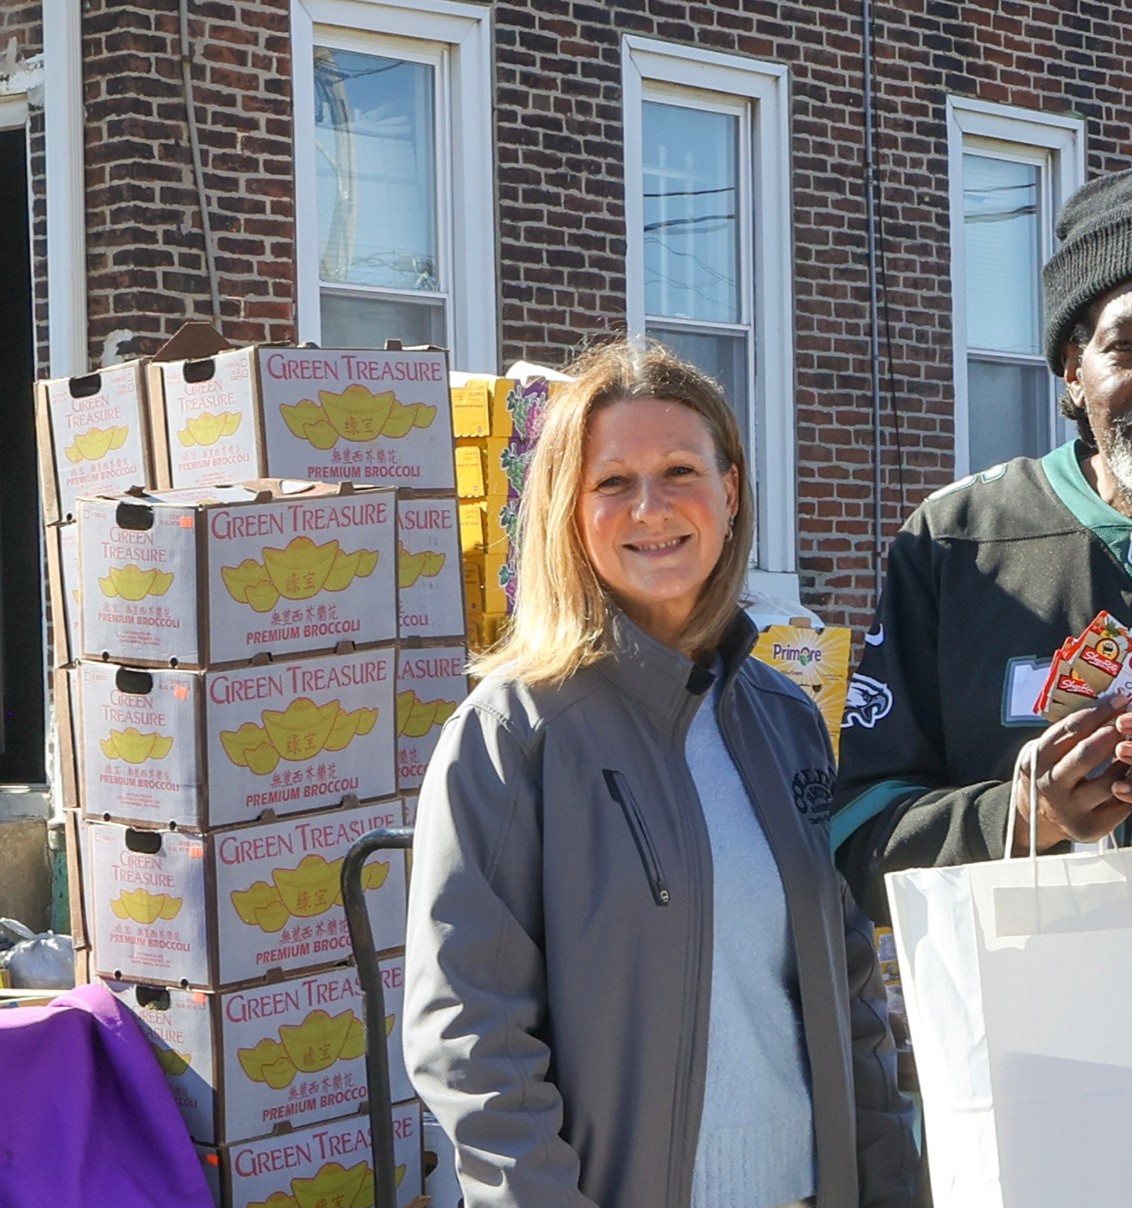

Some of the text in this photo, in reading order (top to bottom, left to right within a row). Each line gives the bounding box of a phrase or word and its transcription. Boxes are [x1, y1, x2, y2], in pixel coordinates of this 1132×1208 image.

[267, 354, 339, 380] GREEN
[341, 355, 442, 381] TREASURE
[71, 393, 110, 413] GREEN
[178, 393, 235, 413] TREASURE
[65, 407, 122, 429] TREASURE
[178, 454, 250, 472] PREMIUM BROCCOLI
[308, 465, 420, 478] PREMIUM BROCCOLI
[66, 472, 100, 487] PREMIUM
[100, 465, 137, 483] BROCCOLI
[211, 510, 284, 541] GREEN
[288, 502, 387, 532] TREASURE
[398, 509, 453, 530] SURE
[110, 526, 154, 545] GREEN
[101, 542, 167, 562] TREASURE
[98, 612, 180, 628] PREMIUM BROCCOLI
[399, 614, 429, 627] COLI
[246, 619, 361, 645] PREMIUM BROCCOLI
[401, 658, 462, 680] ASURE
[209, 675, 283, 705] GREEN
[286, 660, 388, 693] TREASURE
[110, 689, 154, 709] GREEN
[101, 705, 166, 727] TREASURE
[99, 774, 180, 792] PREMIUM BROCCOLI
[246, 777, 359, 807] PREMIUM BROCCOLI
[120, 851, 162, 870] GREEN
[219, 836, 293, 865] GREEN
[112, 865, 175, 888] TREASURE
[110, 934, 190, 952] PREMIUM BROCCOLI
[256, 935, 352, 965] PREMIUM BROCC
[226, 989, 299, 1024] GREEN
[262, 1085, 369, 1122] PREMIUM BROCCO
[235, 1140, 312, 1178] GREEN
